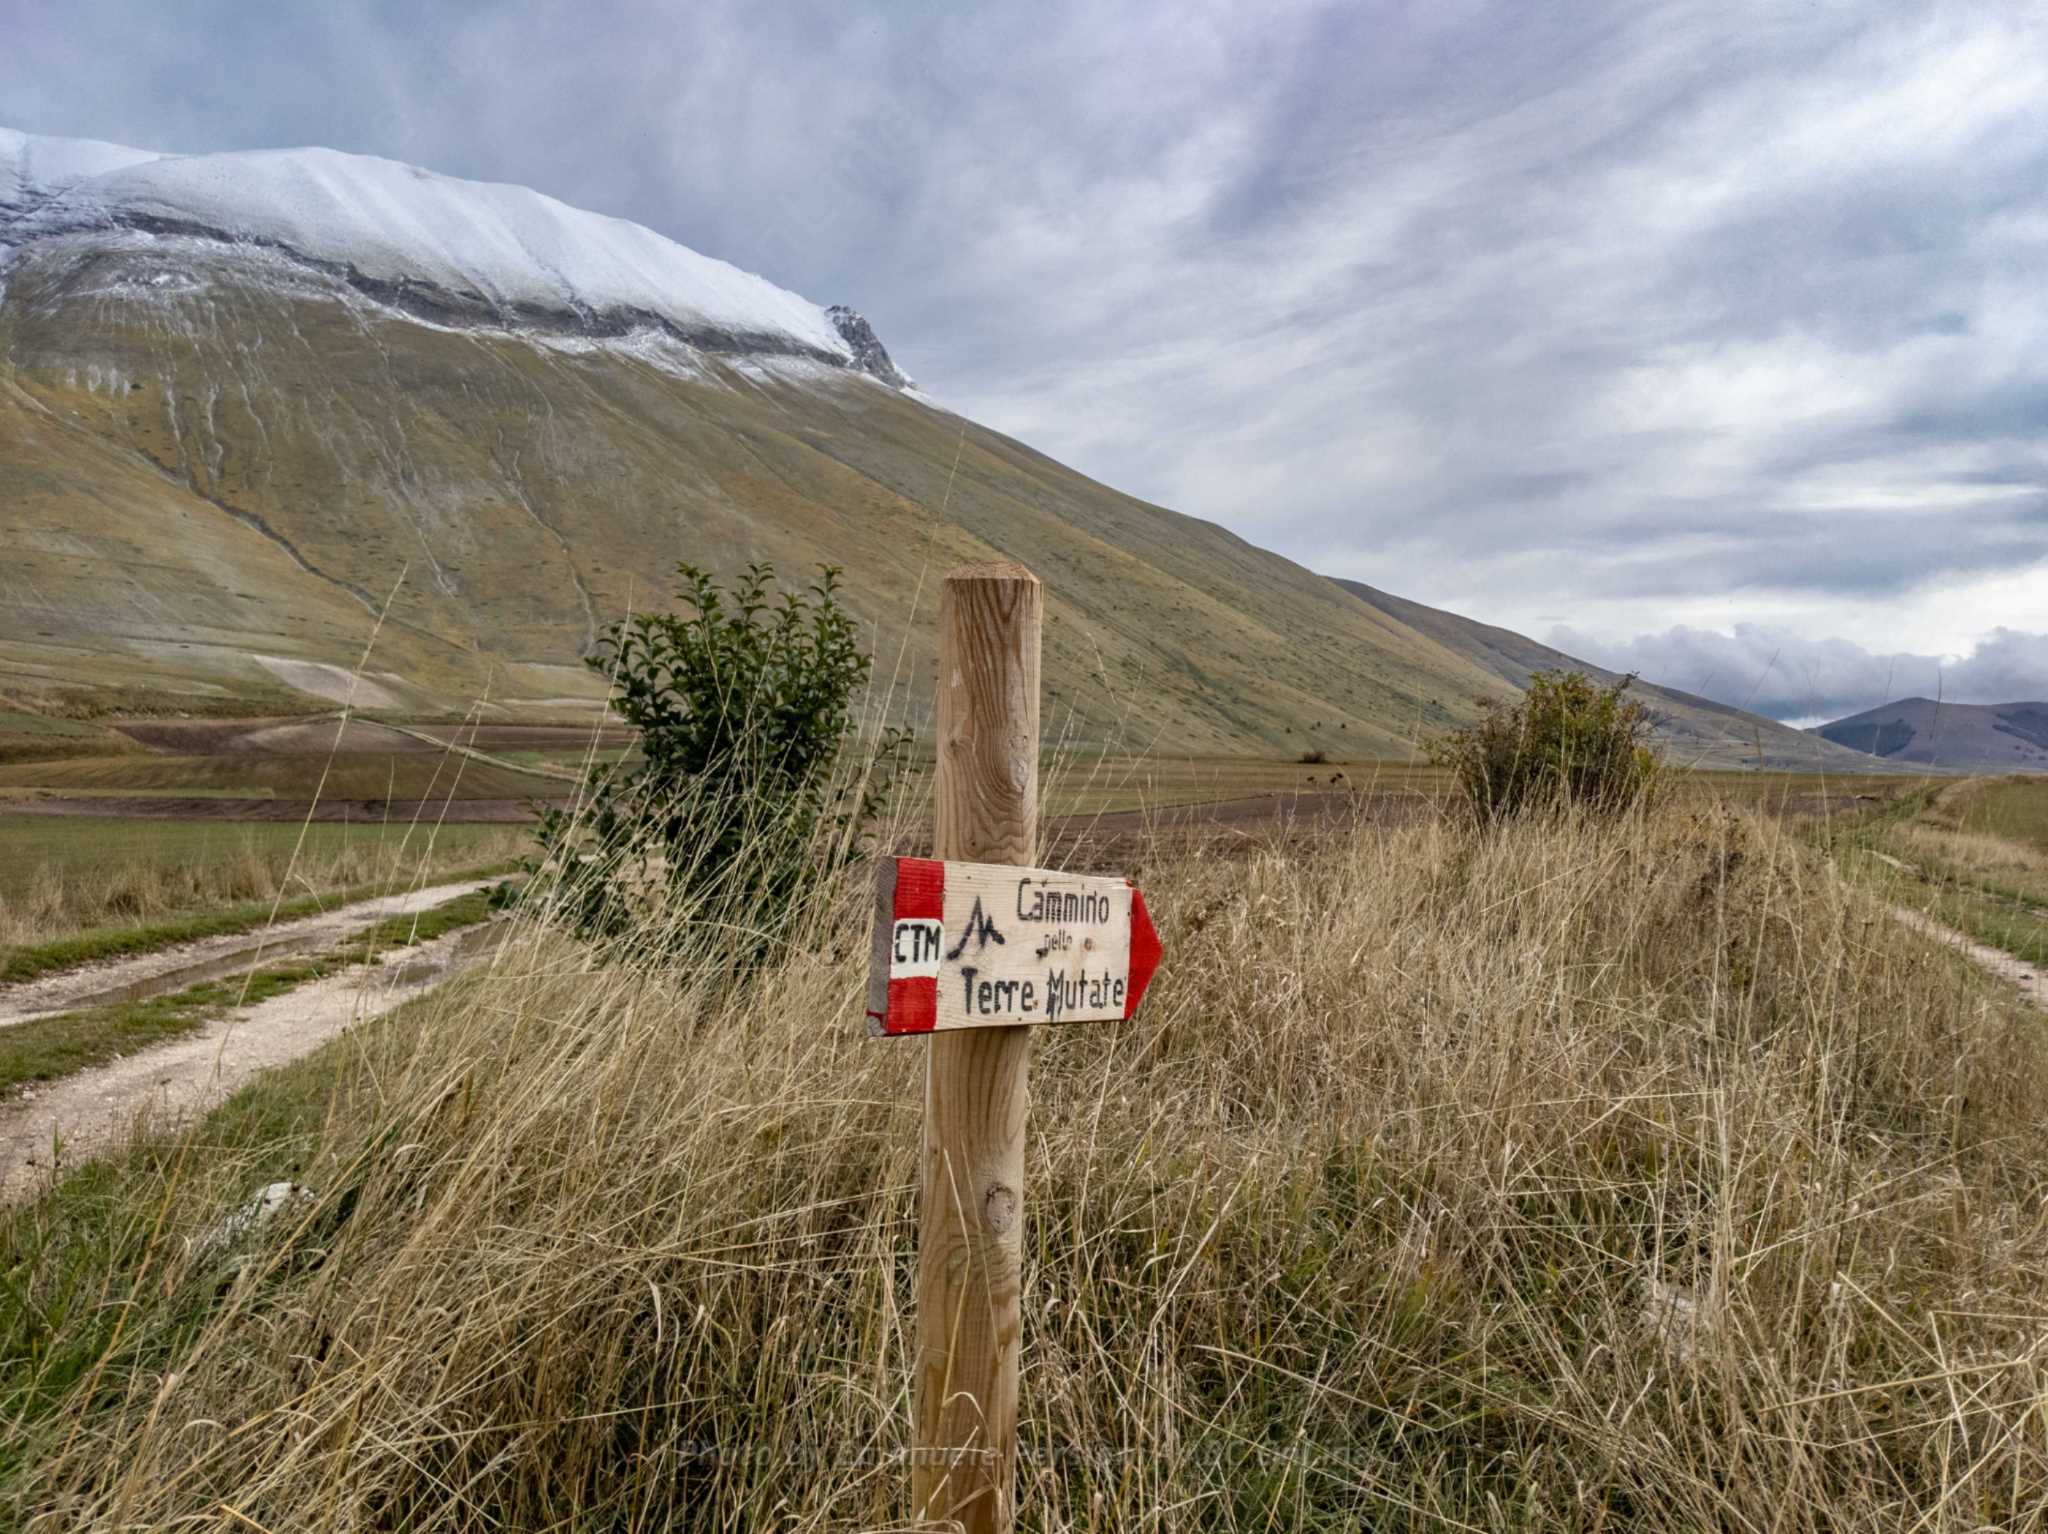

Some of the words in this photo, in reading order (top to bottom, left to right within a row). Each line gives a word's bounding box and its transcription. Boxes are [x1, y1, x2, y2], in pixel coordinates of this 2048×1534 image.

[1017, 877, 1109, 924] Cammino
[894, 924, 941, 962] CTM
[961, 966, 1034, 1015] Terre
[1046, 967, 1125, 1019] Mutate
